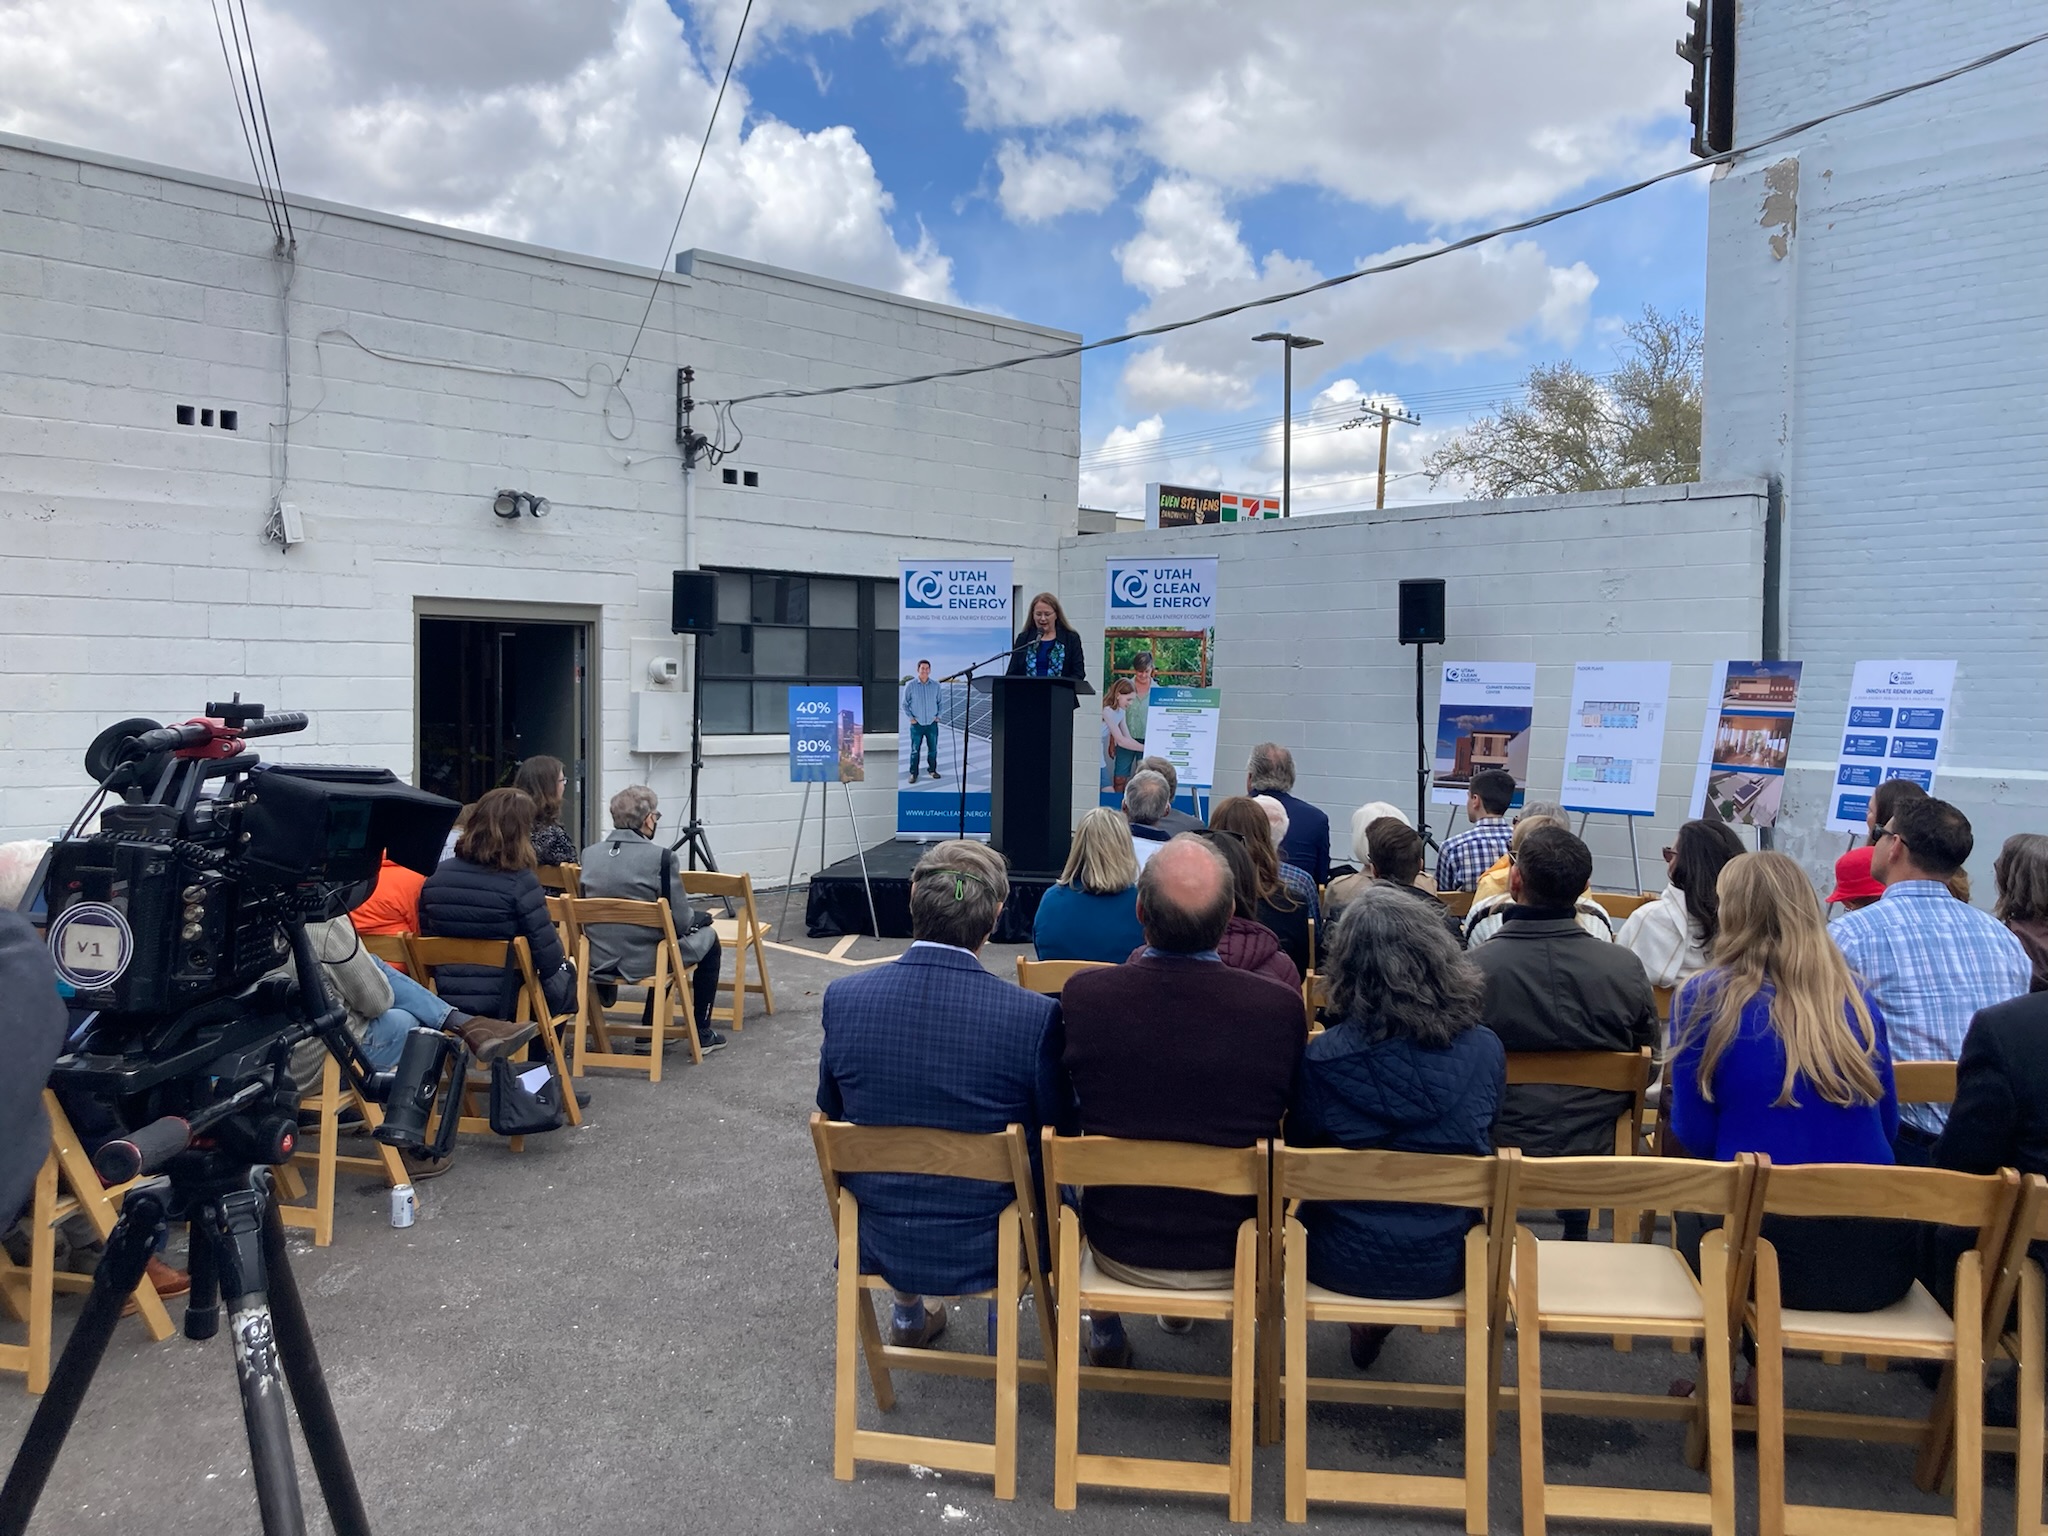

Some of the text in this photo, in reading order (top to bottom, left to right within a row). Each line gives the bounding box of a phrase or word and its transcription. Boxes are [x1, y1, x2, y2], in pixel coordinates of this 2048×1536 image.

[1160, 494, 1219, 512] EVEN STEVENS
[949, 571, 987, 581] UTAH
[1154, 569, 1191, 579] UTAH
[949, 585, 996, 595] CLEAN
[1154, 583, 1200, 594] CLEAN
[949, 599, 1006, 609] ENERGY
[1154, 597, 1210, 607] ENERGY
[796, 702, 831, 714] 40%
[797, 740, 831, 752] 80%
